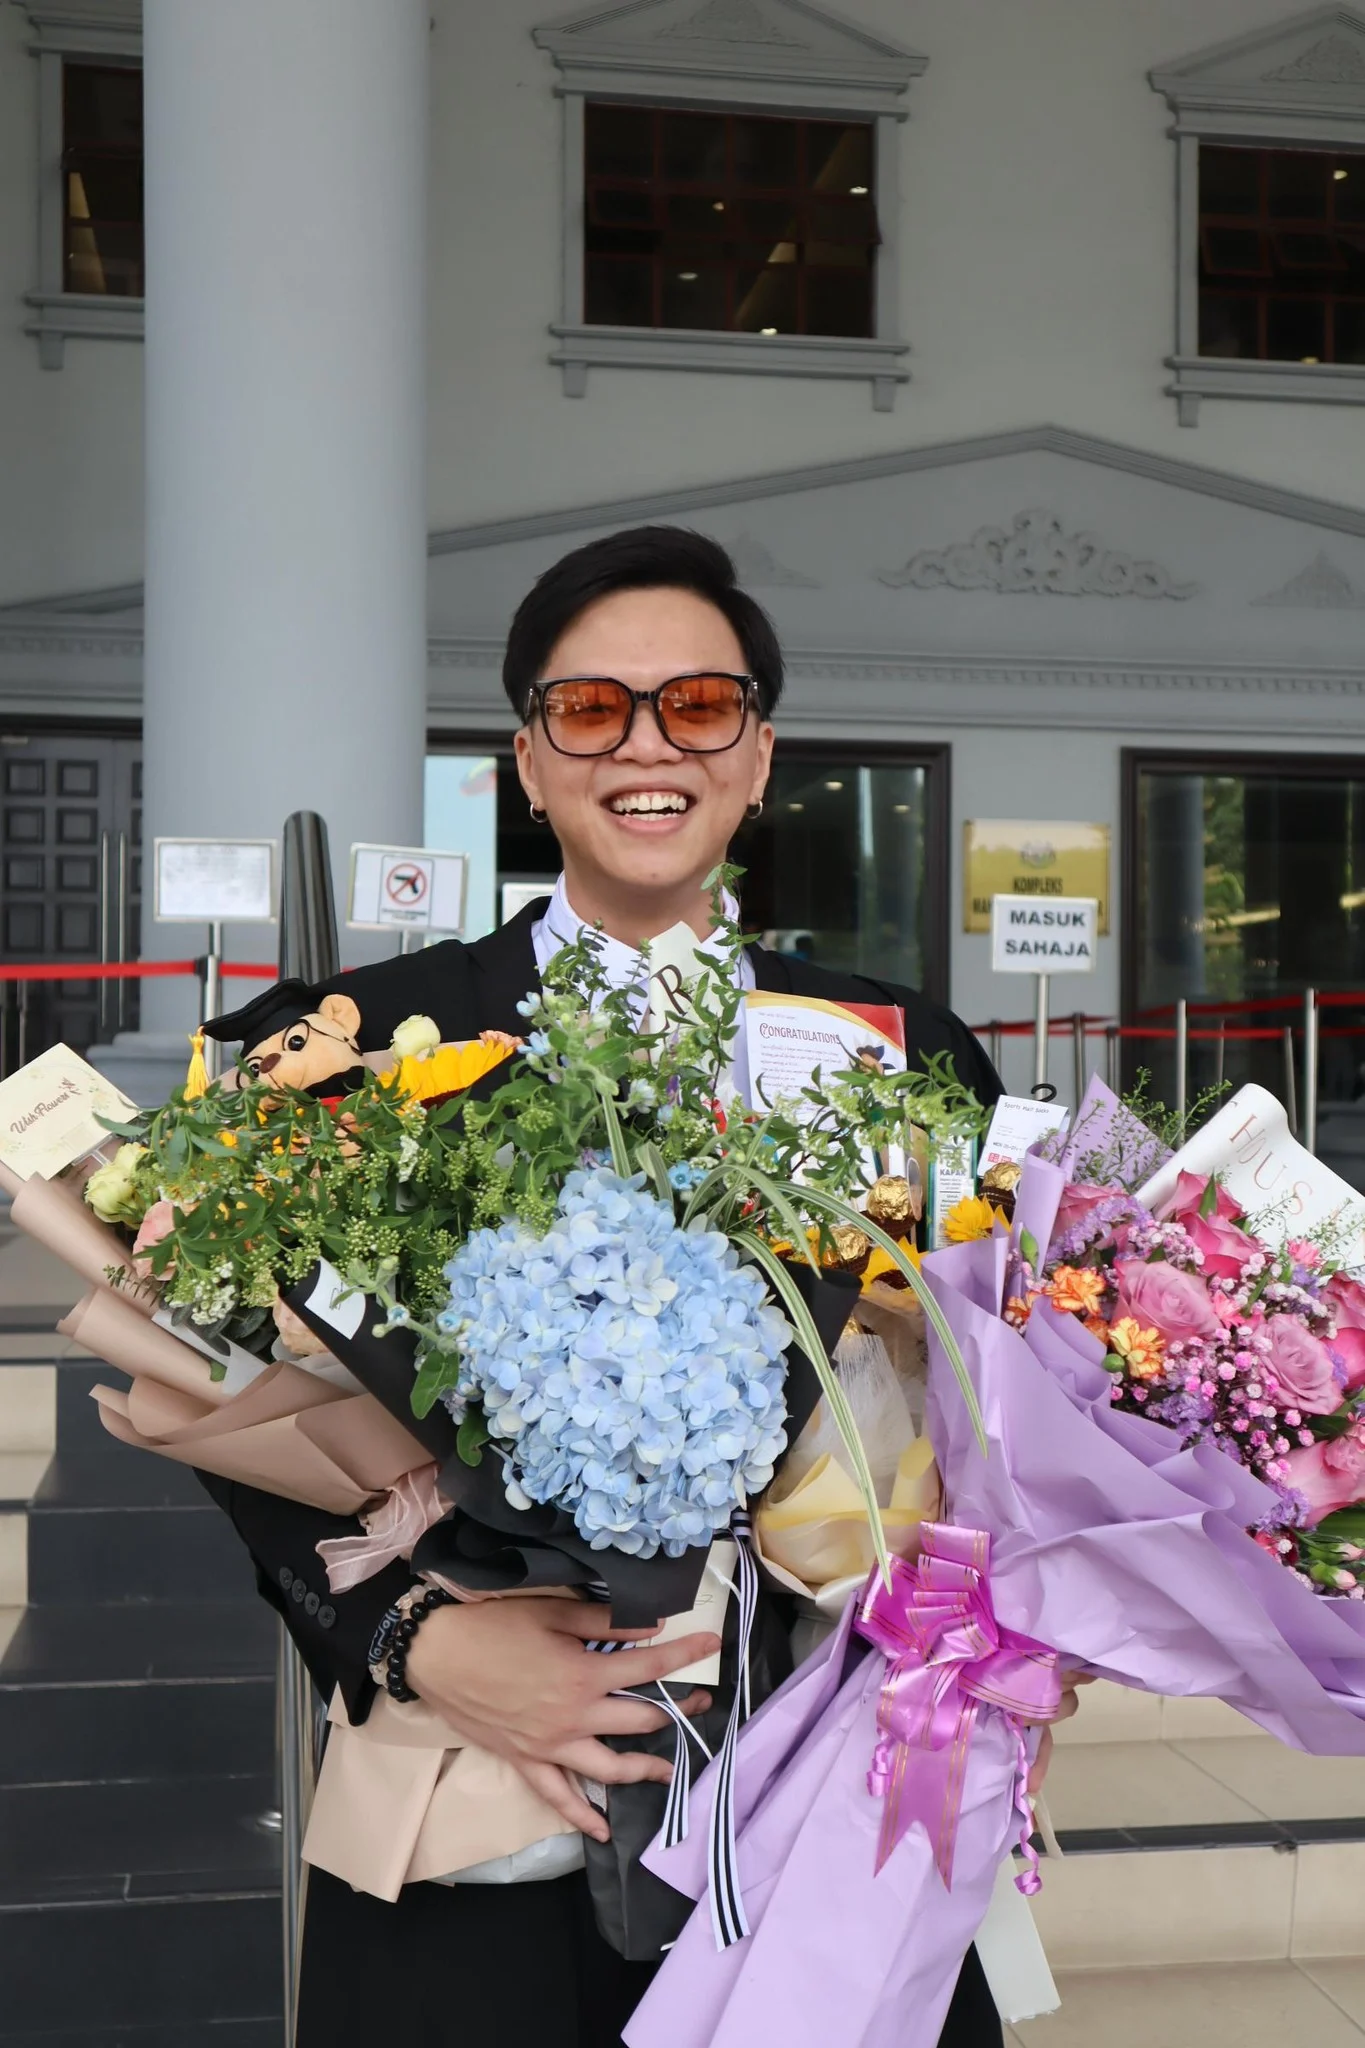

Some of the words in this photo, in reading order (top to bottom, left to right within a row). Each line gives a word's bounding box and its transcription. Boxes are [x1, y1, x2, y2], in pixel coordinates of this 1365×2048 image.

[1013, 877, 1063, 893] KOMPLEKS
[1010, 910, 1085, 927] MASUK
[1005, 939, 1090, 957] SAHAJA
